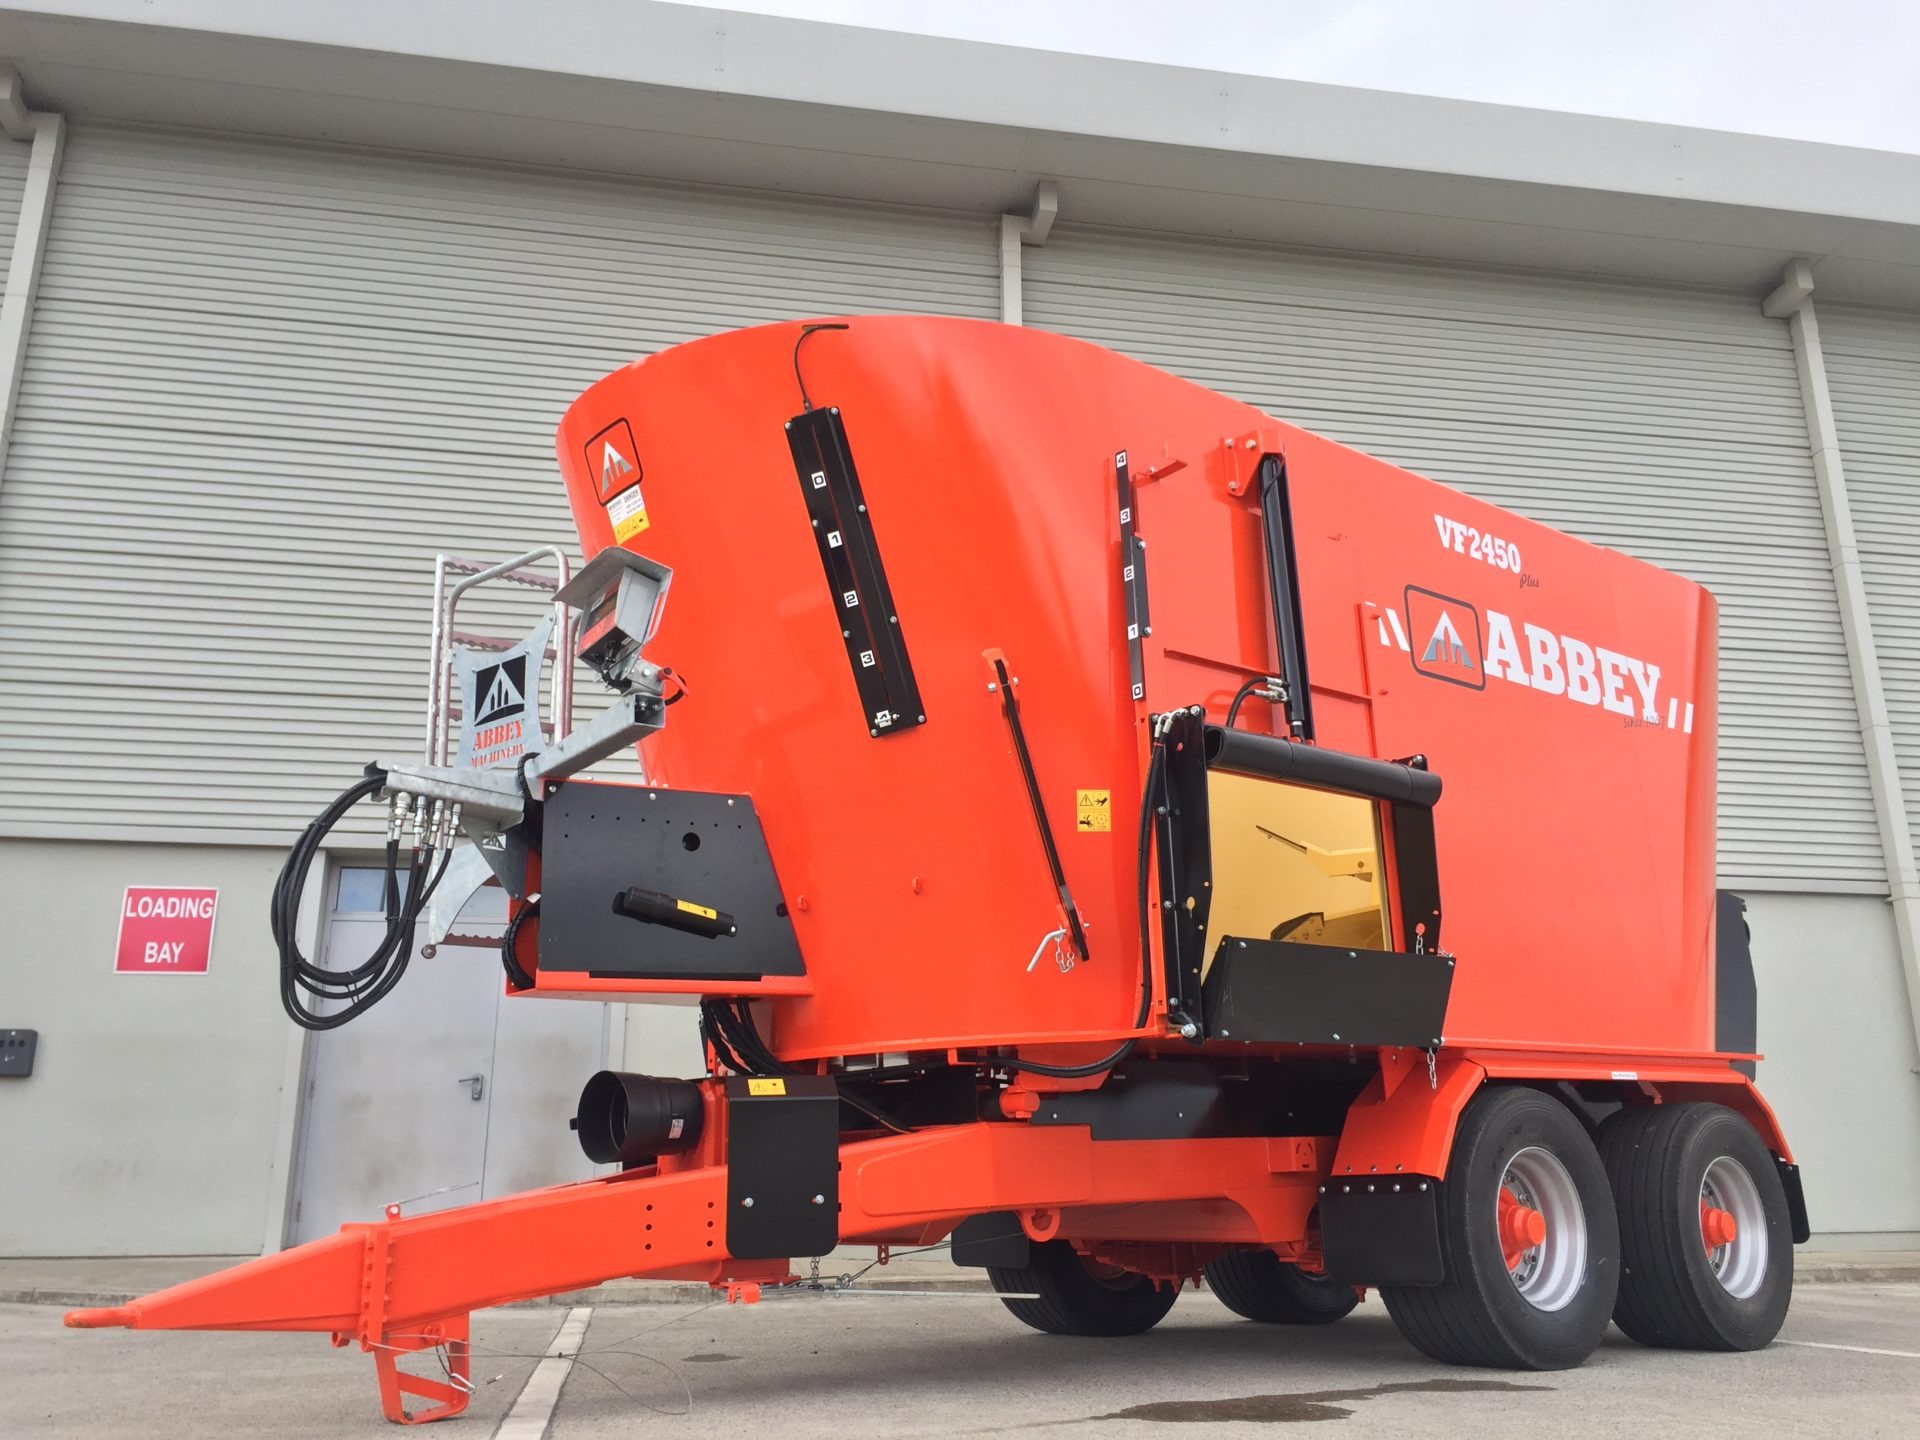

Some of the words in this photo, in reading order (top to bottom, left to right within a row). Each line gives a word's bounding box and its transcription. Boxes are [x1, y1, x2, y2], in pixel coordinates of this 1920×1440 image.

[1434, 513, 1521, 574] VF2450
[1520, 573, 1540, 589] Plus
[845, 593, 857, 605] 2
[862, 653, 873, 665] 3
[1483, 609, 1661, 724] ABBEY
[473, 719, 524, 751] ABBEY
[471, 744, 524, 768] MACHINERY
[125, 896, 214, 919] LOADING
[143, 941, 185, 964] BAY
